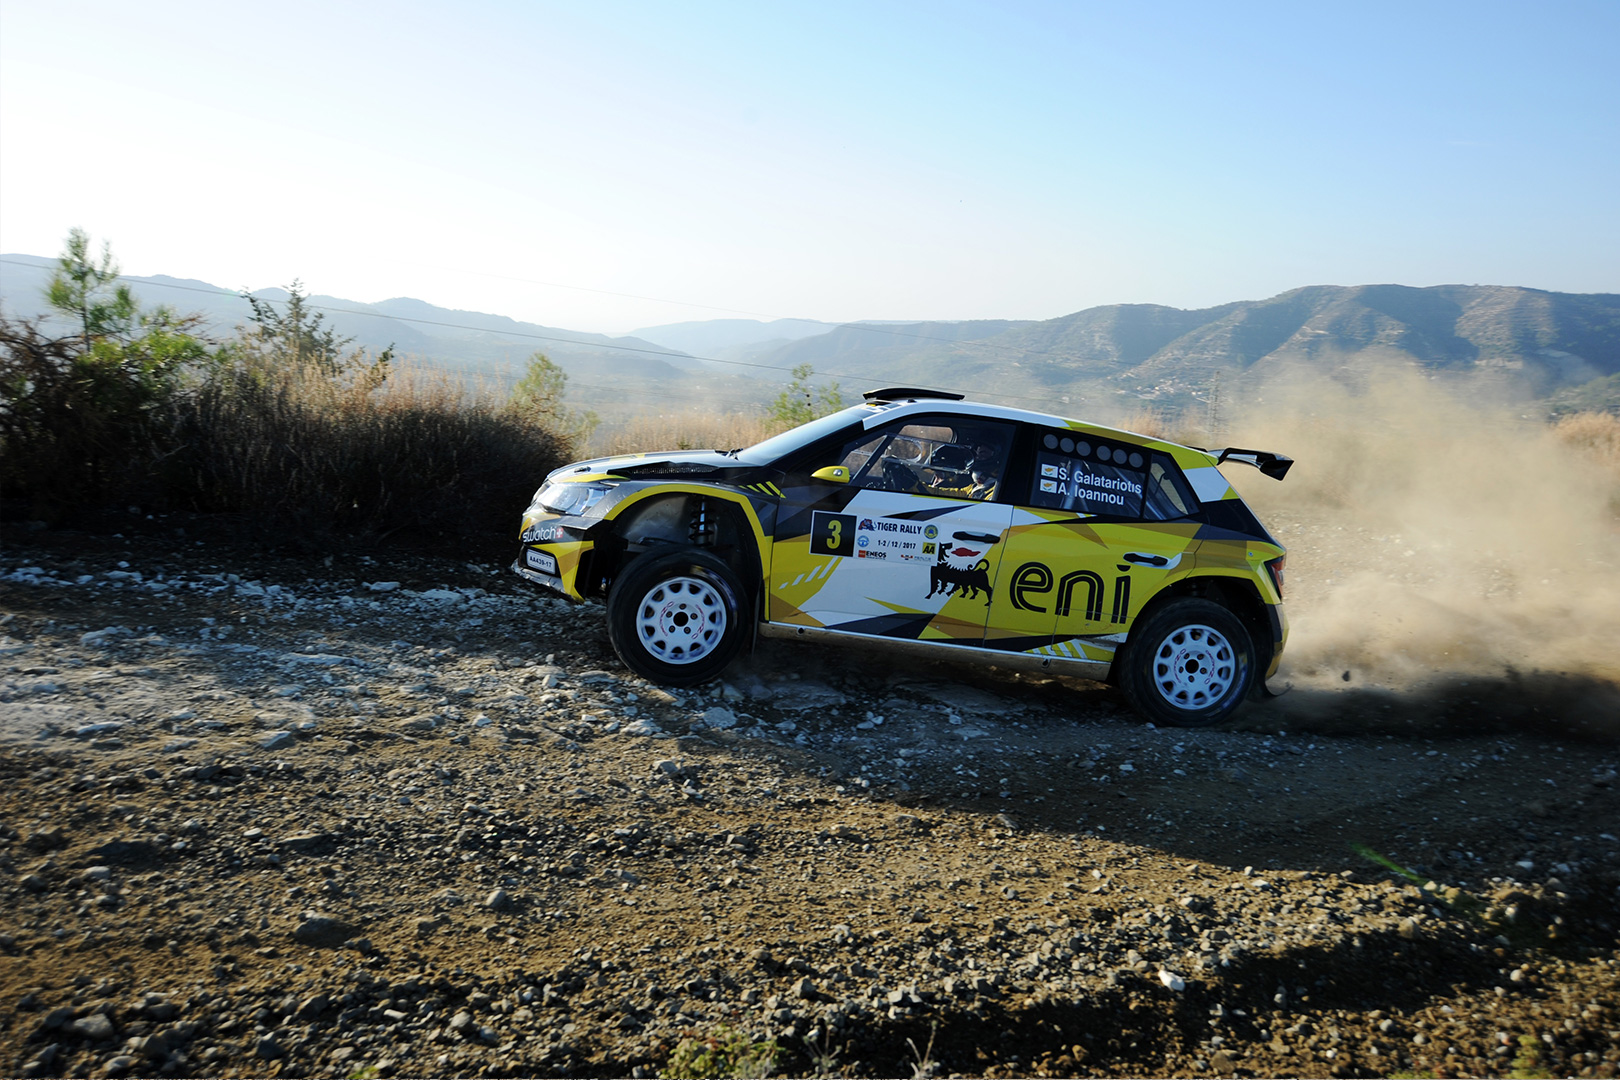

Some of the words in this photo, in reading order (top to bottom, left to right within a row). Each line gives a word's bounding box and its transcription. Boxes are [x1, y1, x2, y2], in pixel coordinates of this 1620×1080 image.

[1058, 467, 1070, 481] S.
[1074, 470, 1142, 494] Galatariotis
[1057, 482, 1070, 495] A.
[1074, 484, 1124, 506] Ioannou
[522, 526, 557, 543] swatch
[826, 519, 842, 549] 3
[877, 522, 898, 532] TIGER
[900, 524, 922, 535] RALLY
[866, 550, 887, 558] ENEOS
[922, 545, 936, 555] AA
[1009, 561, 1132, 625] eni
